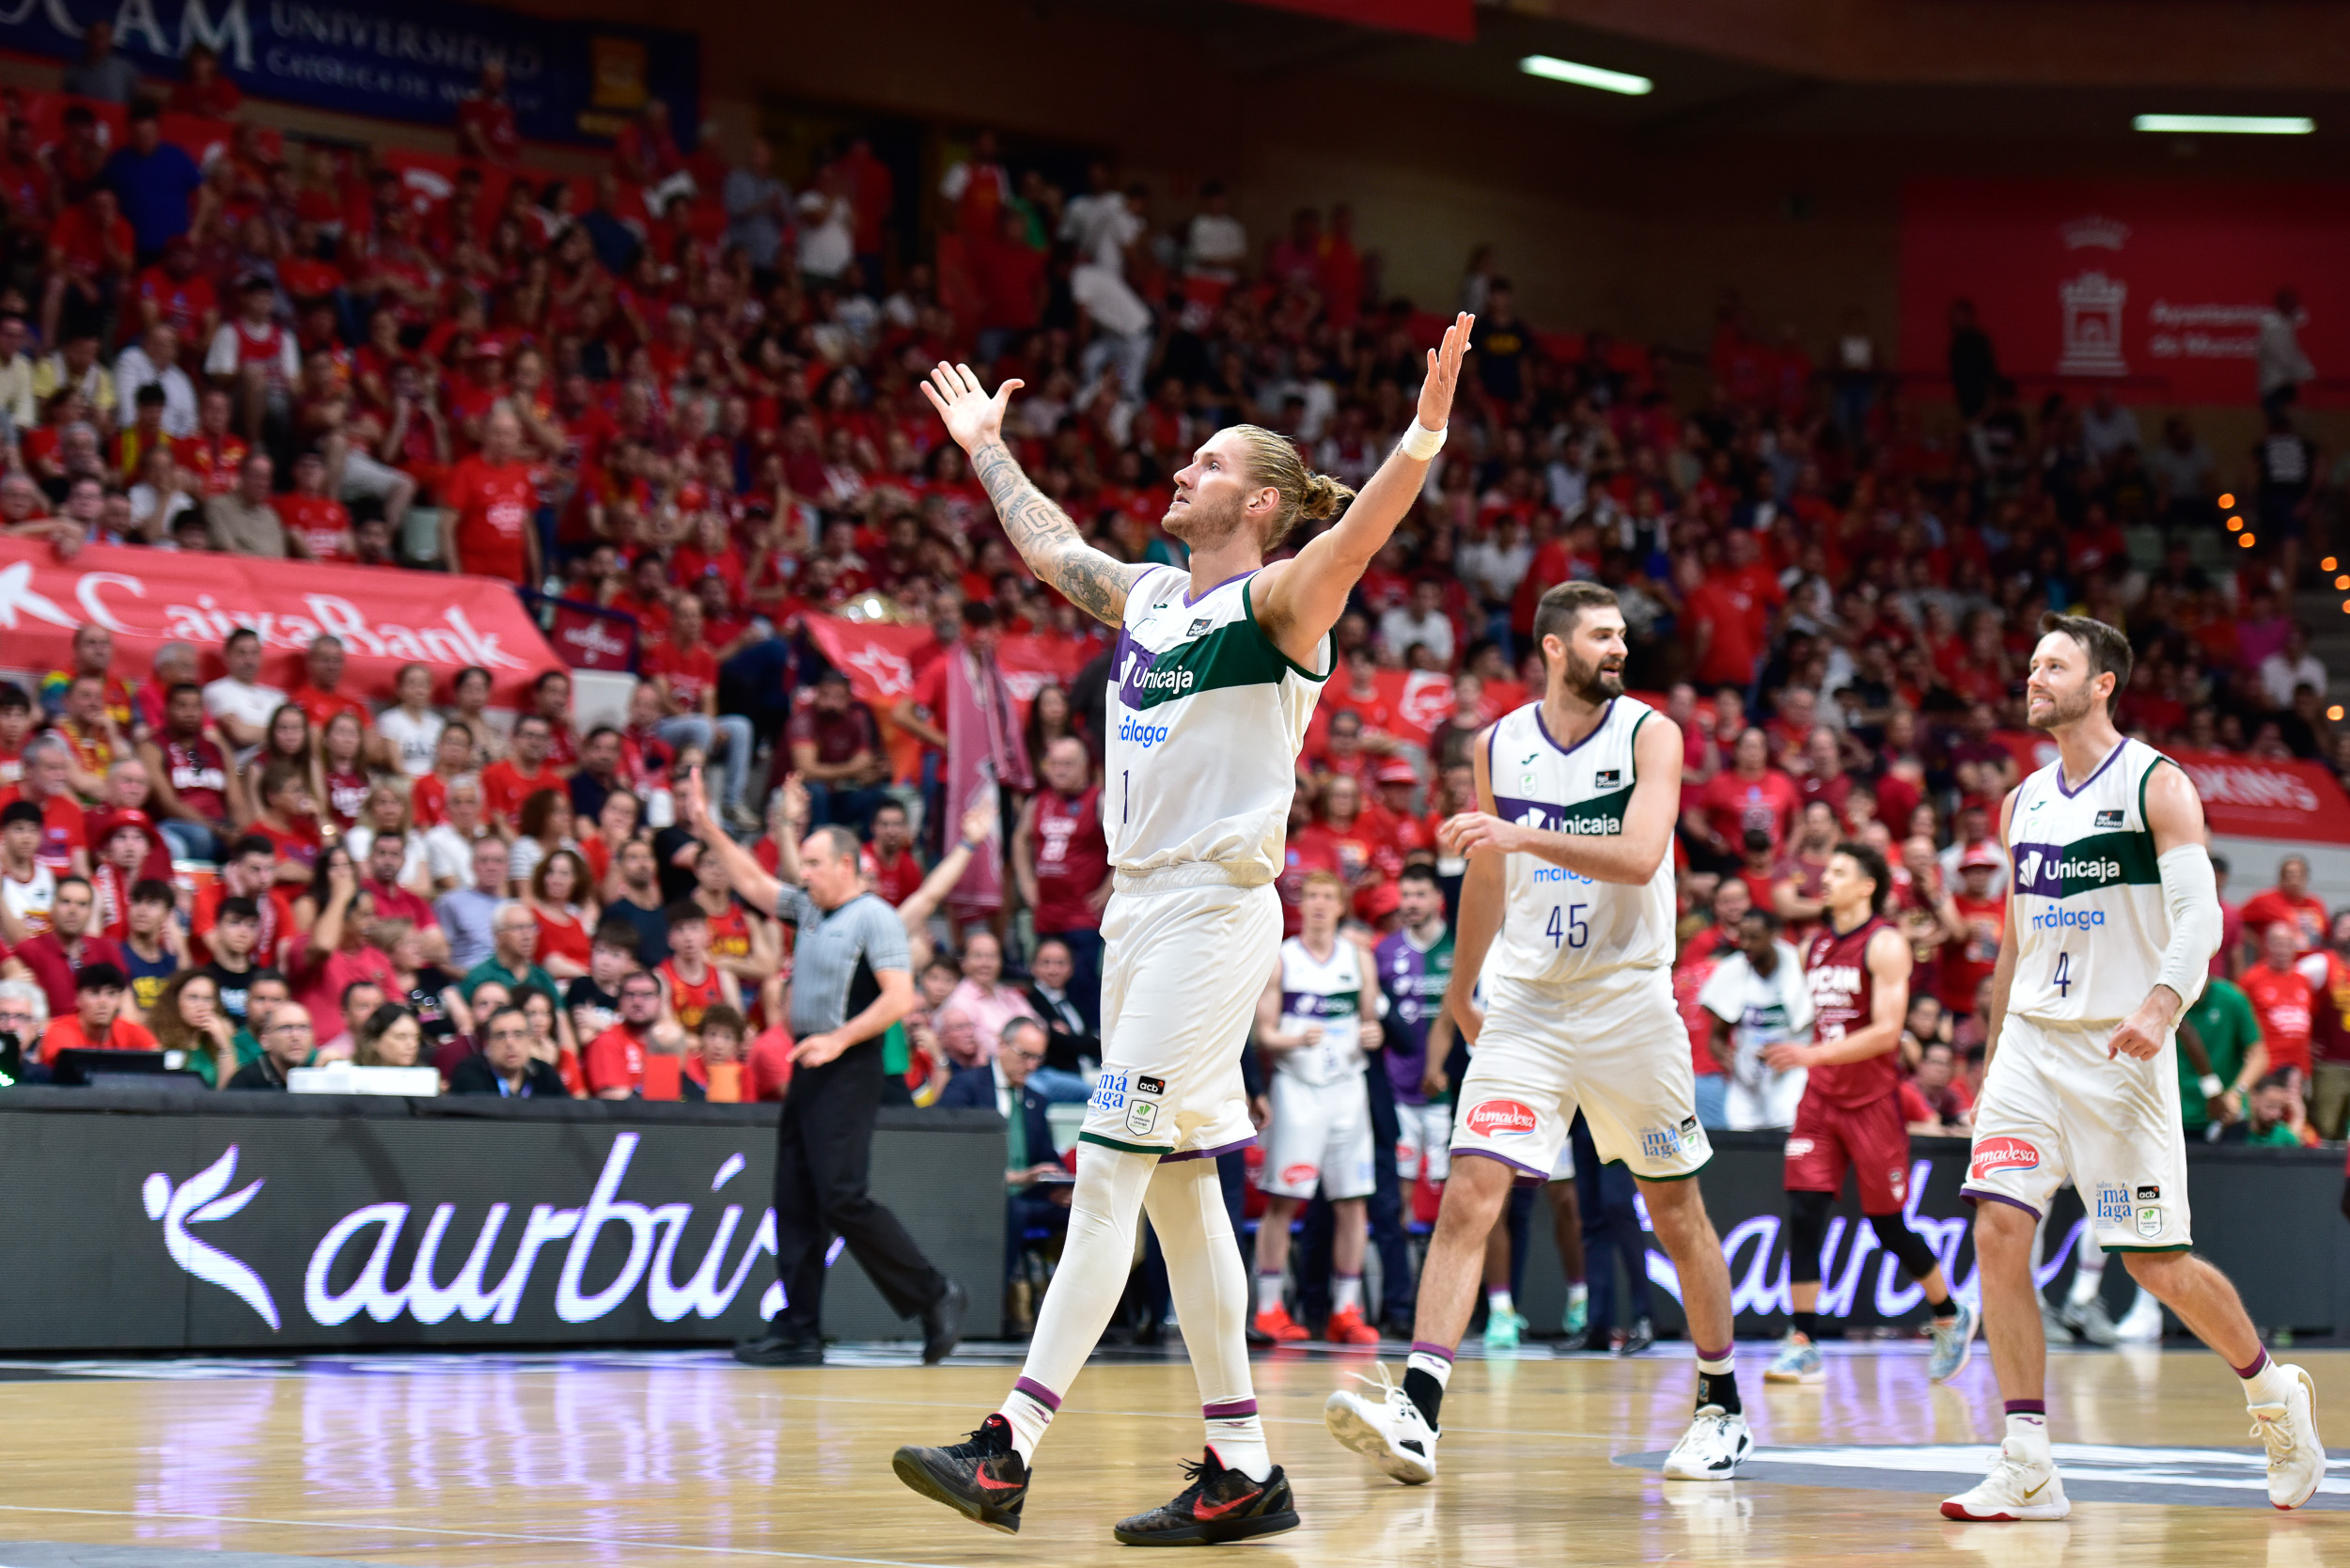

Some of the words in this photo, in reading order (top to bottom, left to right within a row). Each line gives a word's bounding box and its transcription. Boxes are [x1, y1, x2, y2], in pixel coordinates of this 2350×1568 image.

[75, 571, 529, 671] CaixaBank
[1133, 665, 1194, 695] Unicaja
[1122, 769, 1129, 824] 1
[1549, 813, 1621, 836] Unicaja
[2044, 856, 2121, 884] Unicaja
[1545, 903, 1589, 950] 45
[2053, 951, 2072, 998] 4
[1139, 1082, 1159, 1093] acb
[1974, 1140, 2037, 1167] amadesa
